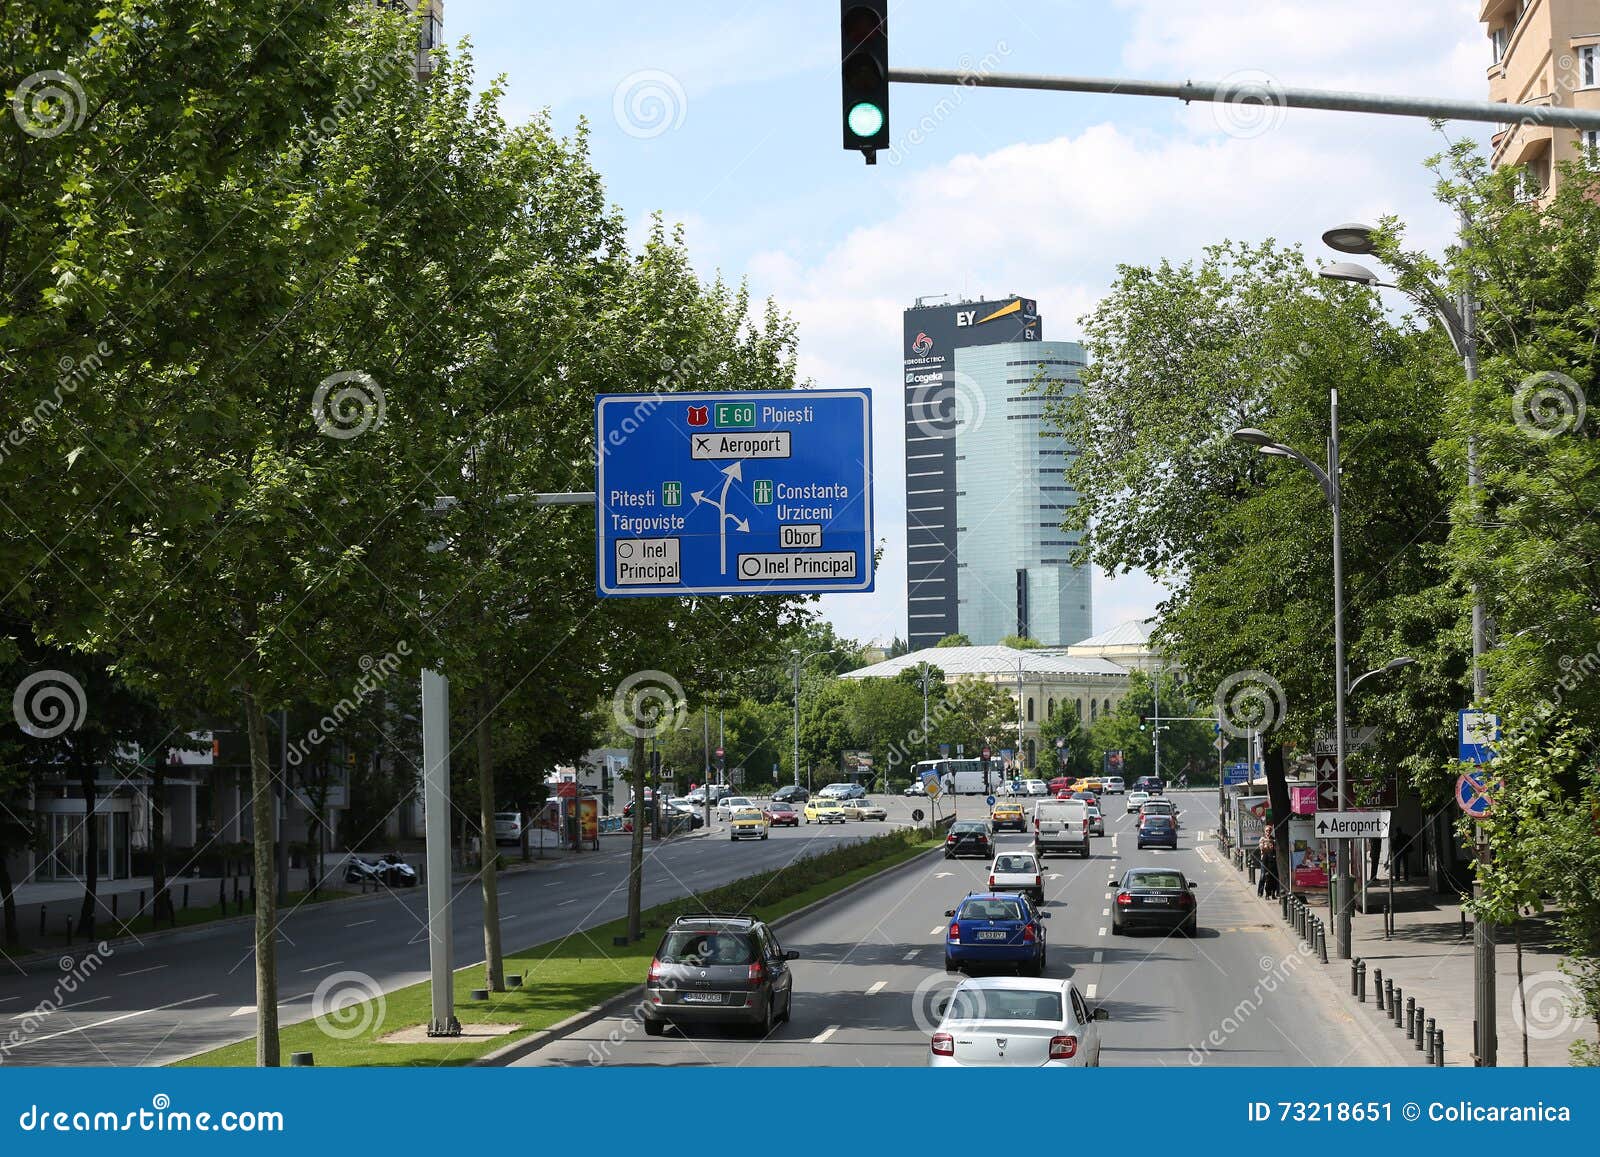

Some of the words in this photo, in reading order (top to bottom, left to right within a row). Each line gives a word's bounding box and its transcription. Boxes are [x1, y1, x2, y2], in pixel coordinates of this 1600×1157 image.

[956, 311, 976, 327] EY
[914, 371, 943, 384] cegeka
[720, 407, 729, 424] E
[734, 407, 752, 423] 60
[719, 435, 781, 456] Aeroport
[777, 504, 833, 520] Urziceni
[784, 528, 817, 545] Obor
[642, 541, 667, 558] Inel
[620, 561, 678, 581] Principal
[764, 557, 789, 574] Inel
[794, 556, 853, 578] Principal
[1330, 818, 1381, 836] Aeroport
